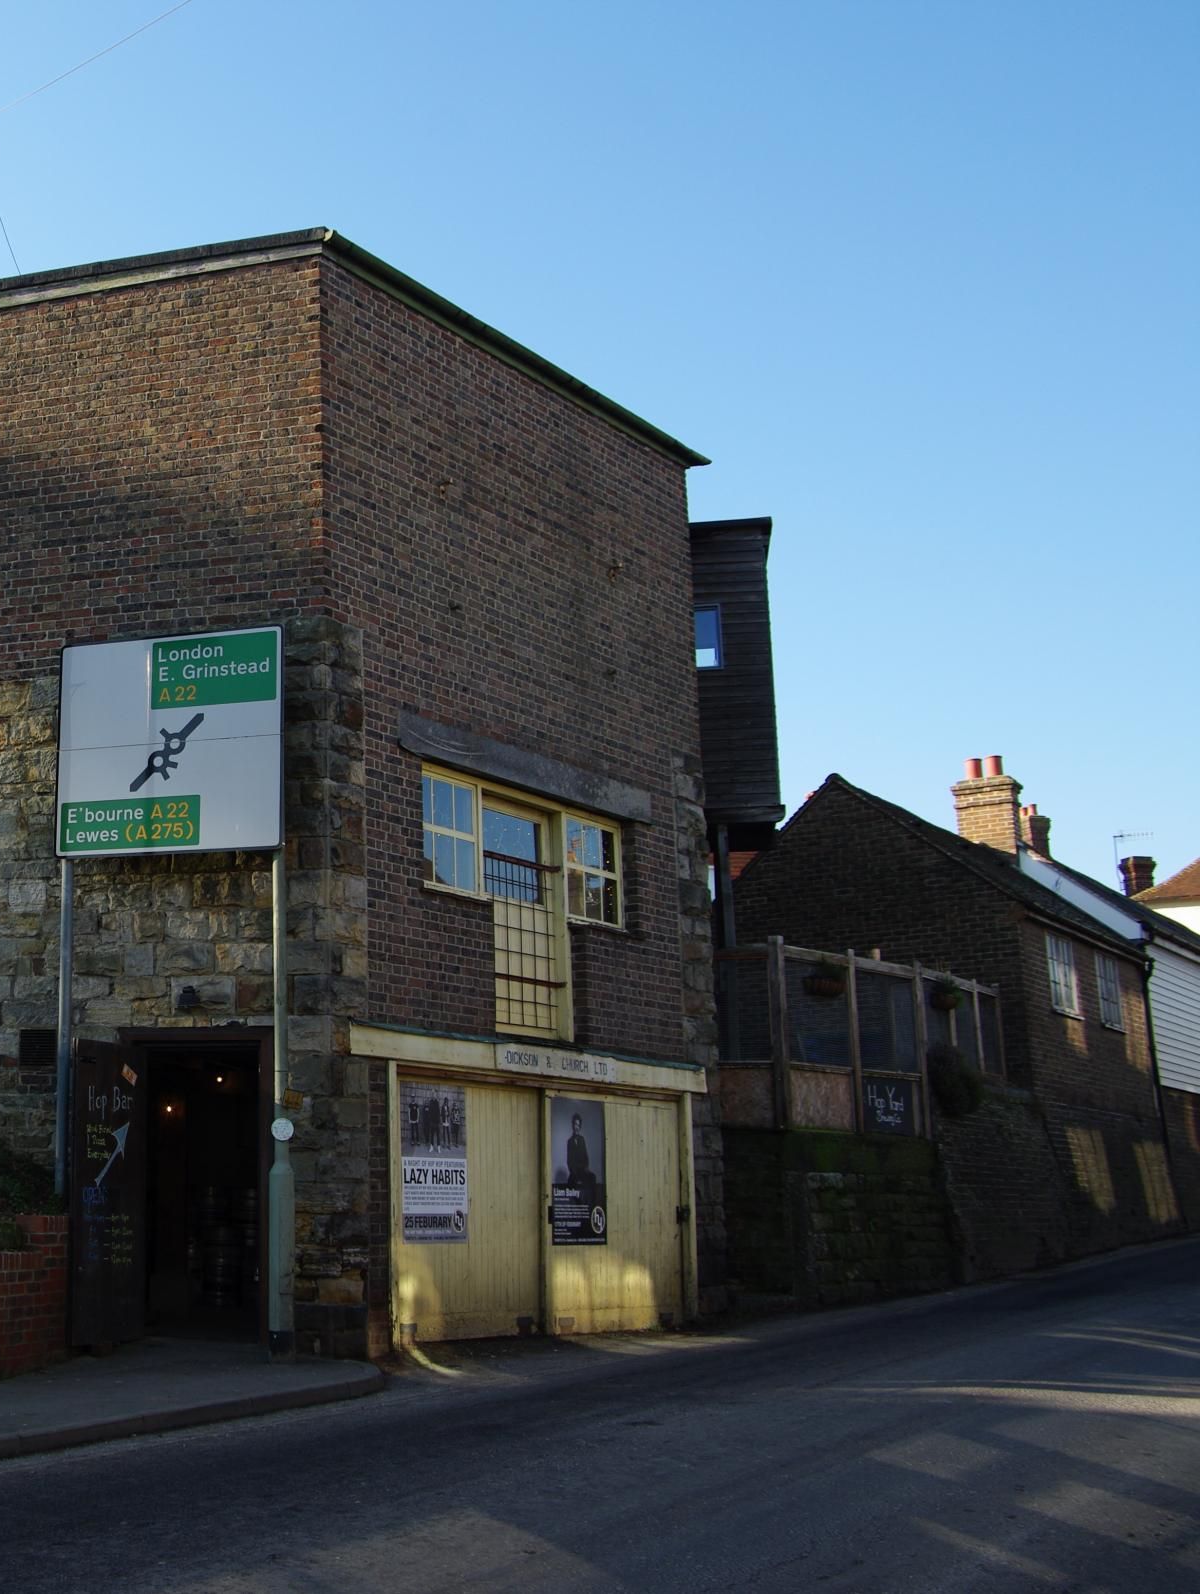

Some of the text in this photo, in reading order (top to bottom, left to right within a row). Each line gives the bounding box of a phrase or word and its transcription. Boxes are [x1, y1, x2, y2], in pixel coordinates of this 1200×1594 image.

[158, 644, 223, 662] London
[158, 658, 270, 682] E. Grinstead
[67, 806, 144, 824] E'bourne
[66, 828, 119, 843] Lewes
[506, 1050, 608, 1076] DICKSON & CHURCH LTD
[88, 1085, 133, 1120] Hop Bar
[867, 1084, 904, 1114] Hop Yard
[403, 1167, 466, 1186] LAZY HABITS
[553, 1187, 580, 1199] Liam Bailey
[404, 1215, 413, 1229] 25
[414, 1215, 452, 1229] FEBURARY
